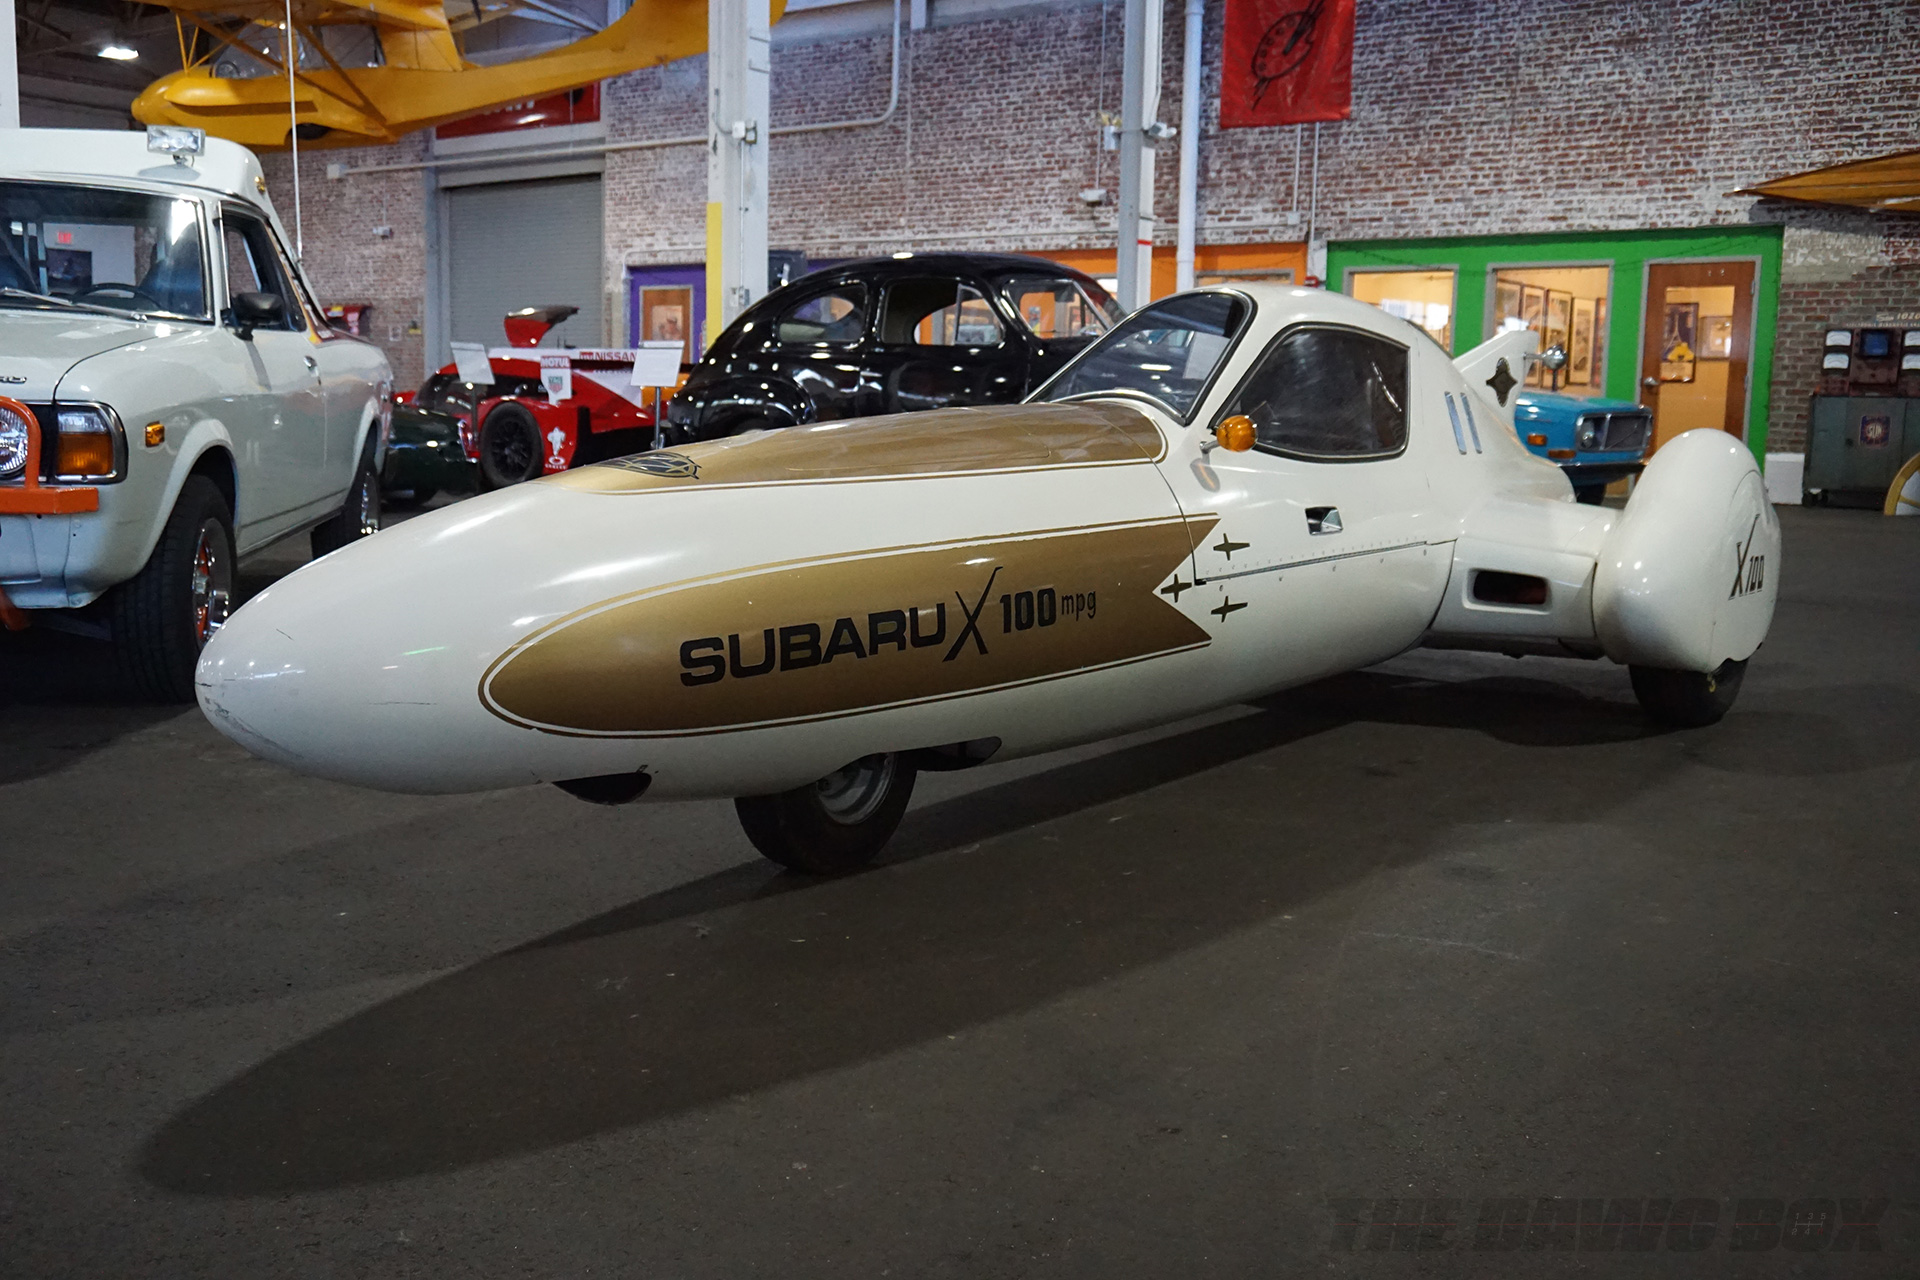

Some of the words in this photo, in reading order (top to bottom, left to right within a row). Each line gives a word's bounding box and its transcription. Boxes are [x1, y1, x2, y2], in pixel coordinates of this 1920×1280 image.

[595, 351, 637, 361] NISSAN
[541, 358, 571, 368] MOTUL
[680, 602, 946, 687] SUBARU
[1061, 587, 1097, 620] mpg
